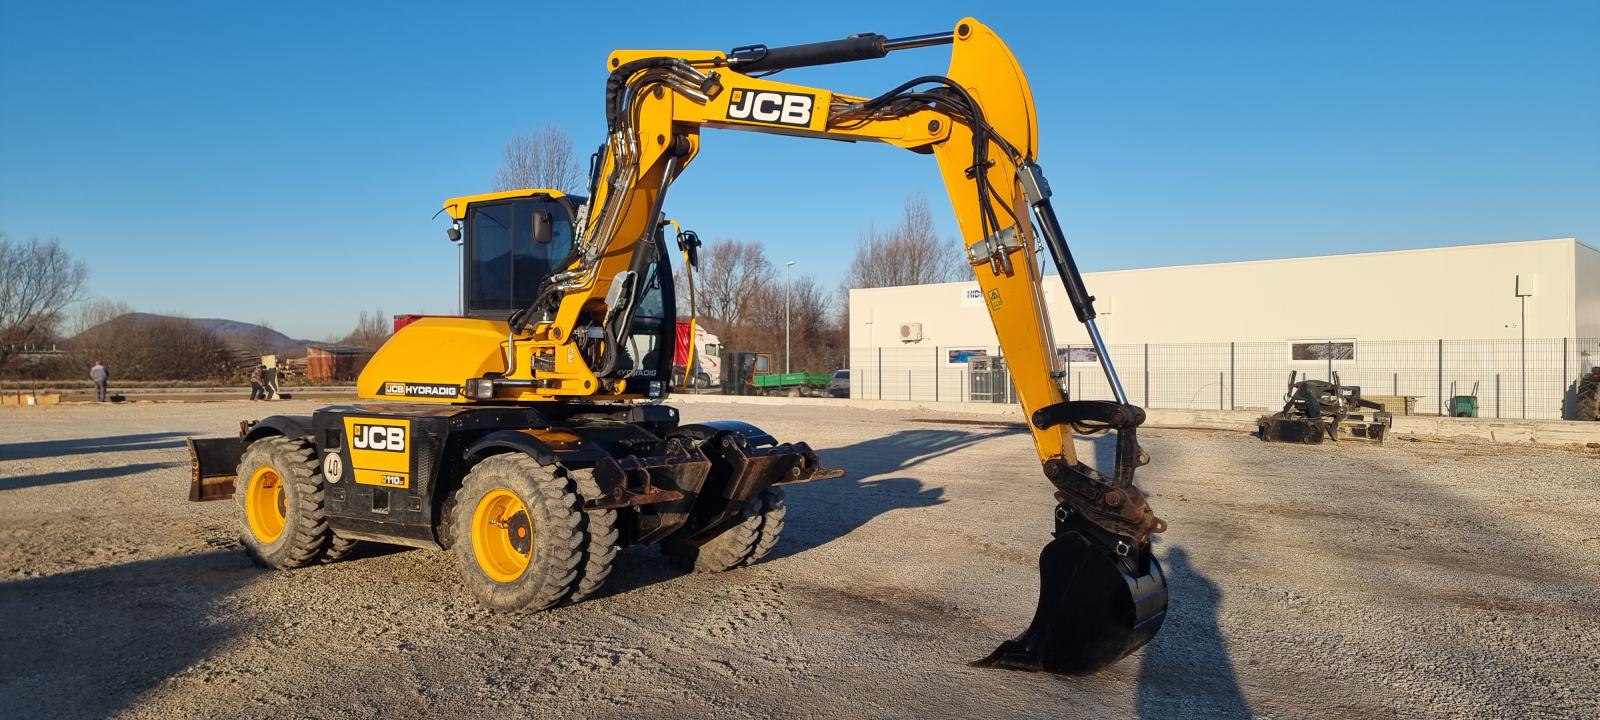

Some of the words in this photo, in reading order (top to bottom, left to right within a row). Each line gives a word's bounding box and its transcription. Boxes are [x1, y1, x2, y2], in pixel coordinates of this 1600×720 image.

[729, 91, 812, 125] JCB
[386, 385, 404, 393] JCB
[405, 385, 456, 396] HYDRADIG
[354, 426, 405, 451] JCB
[328, 459, 338, 476] 40
